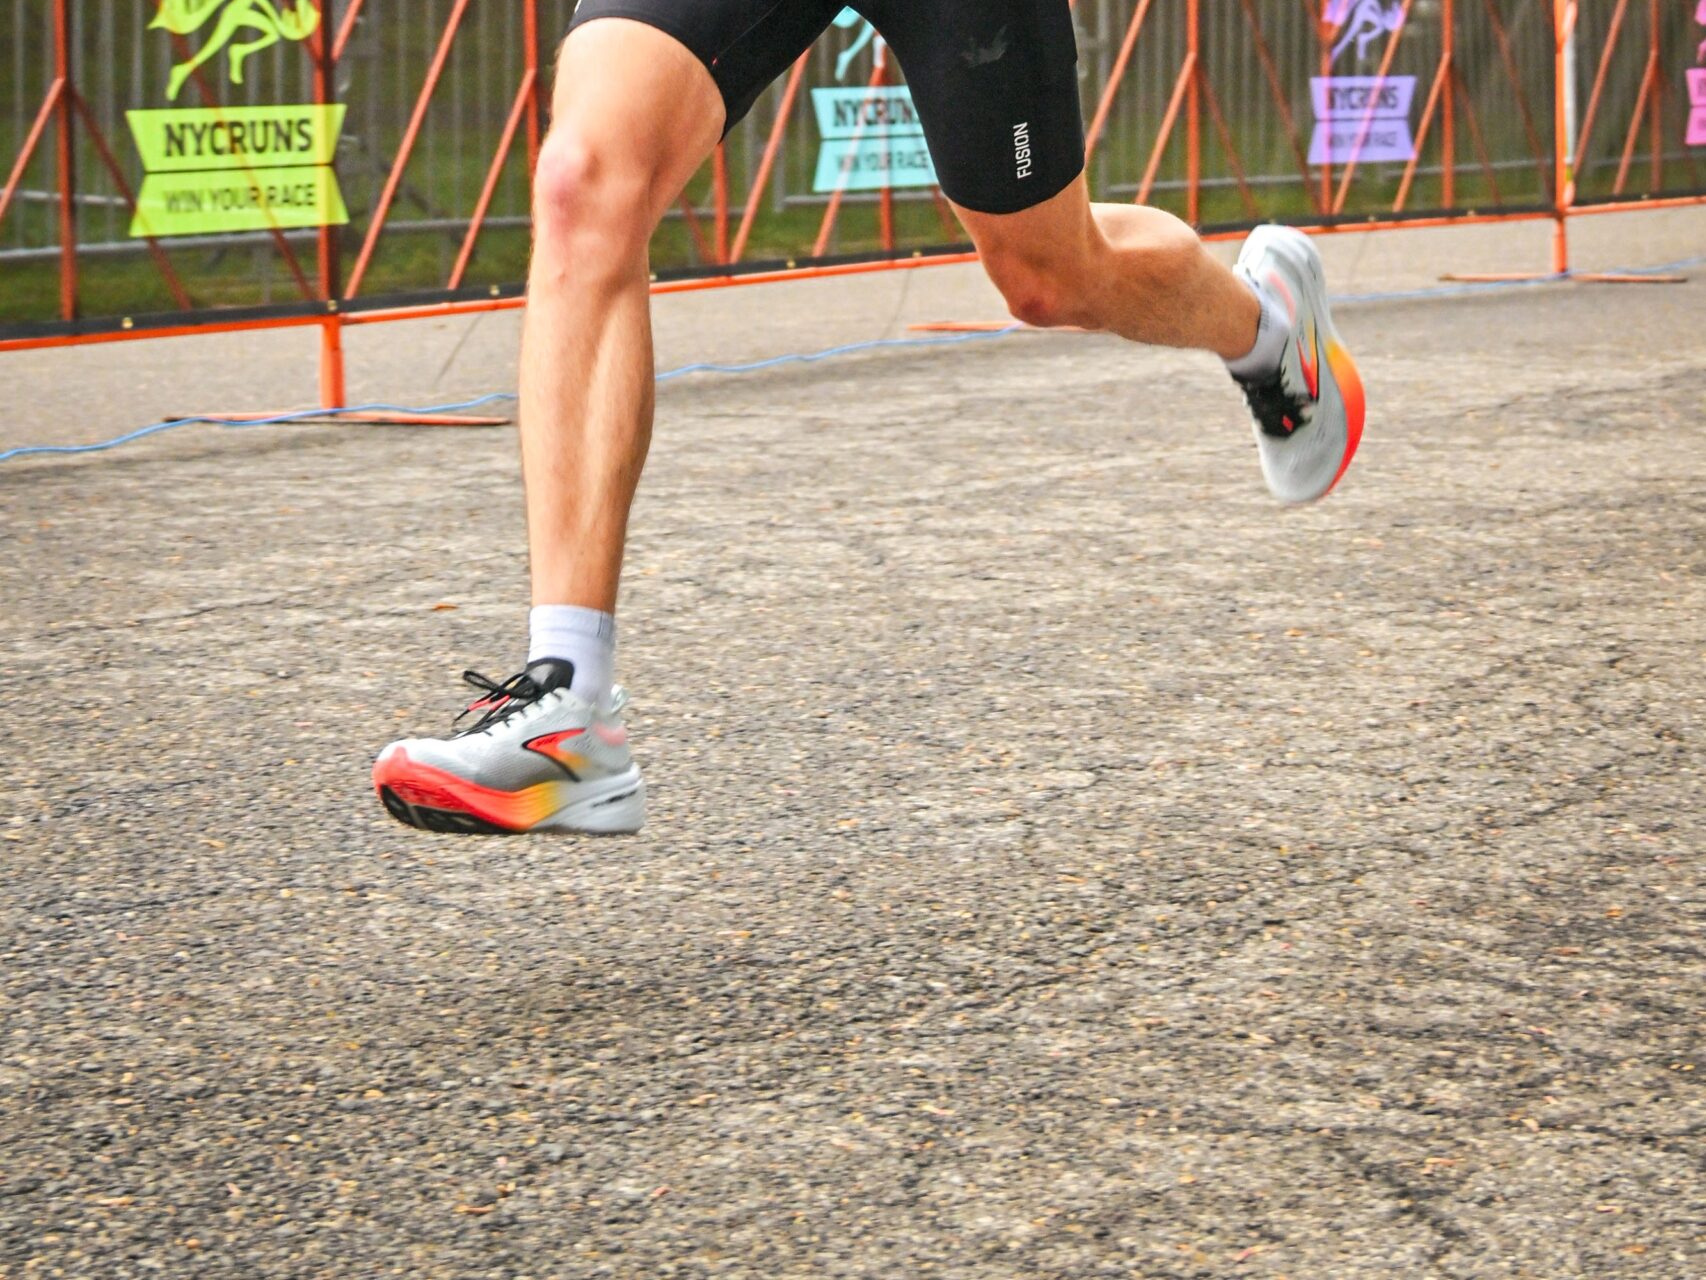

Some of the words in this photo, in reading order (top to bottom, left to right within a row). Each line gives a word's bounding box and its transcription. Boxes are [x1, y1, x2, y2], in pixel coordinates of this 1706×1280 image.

[834, 98, 920, 127] NYCRUN
[165, 118, 312, 157] NYCRUNS
[1013, 122, 1032, 179] FUSION
[164, 190, 203, 213] WIN
[210, 186, 260, 210] YOUR
[268, 183, 315, 207] RACE
